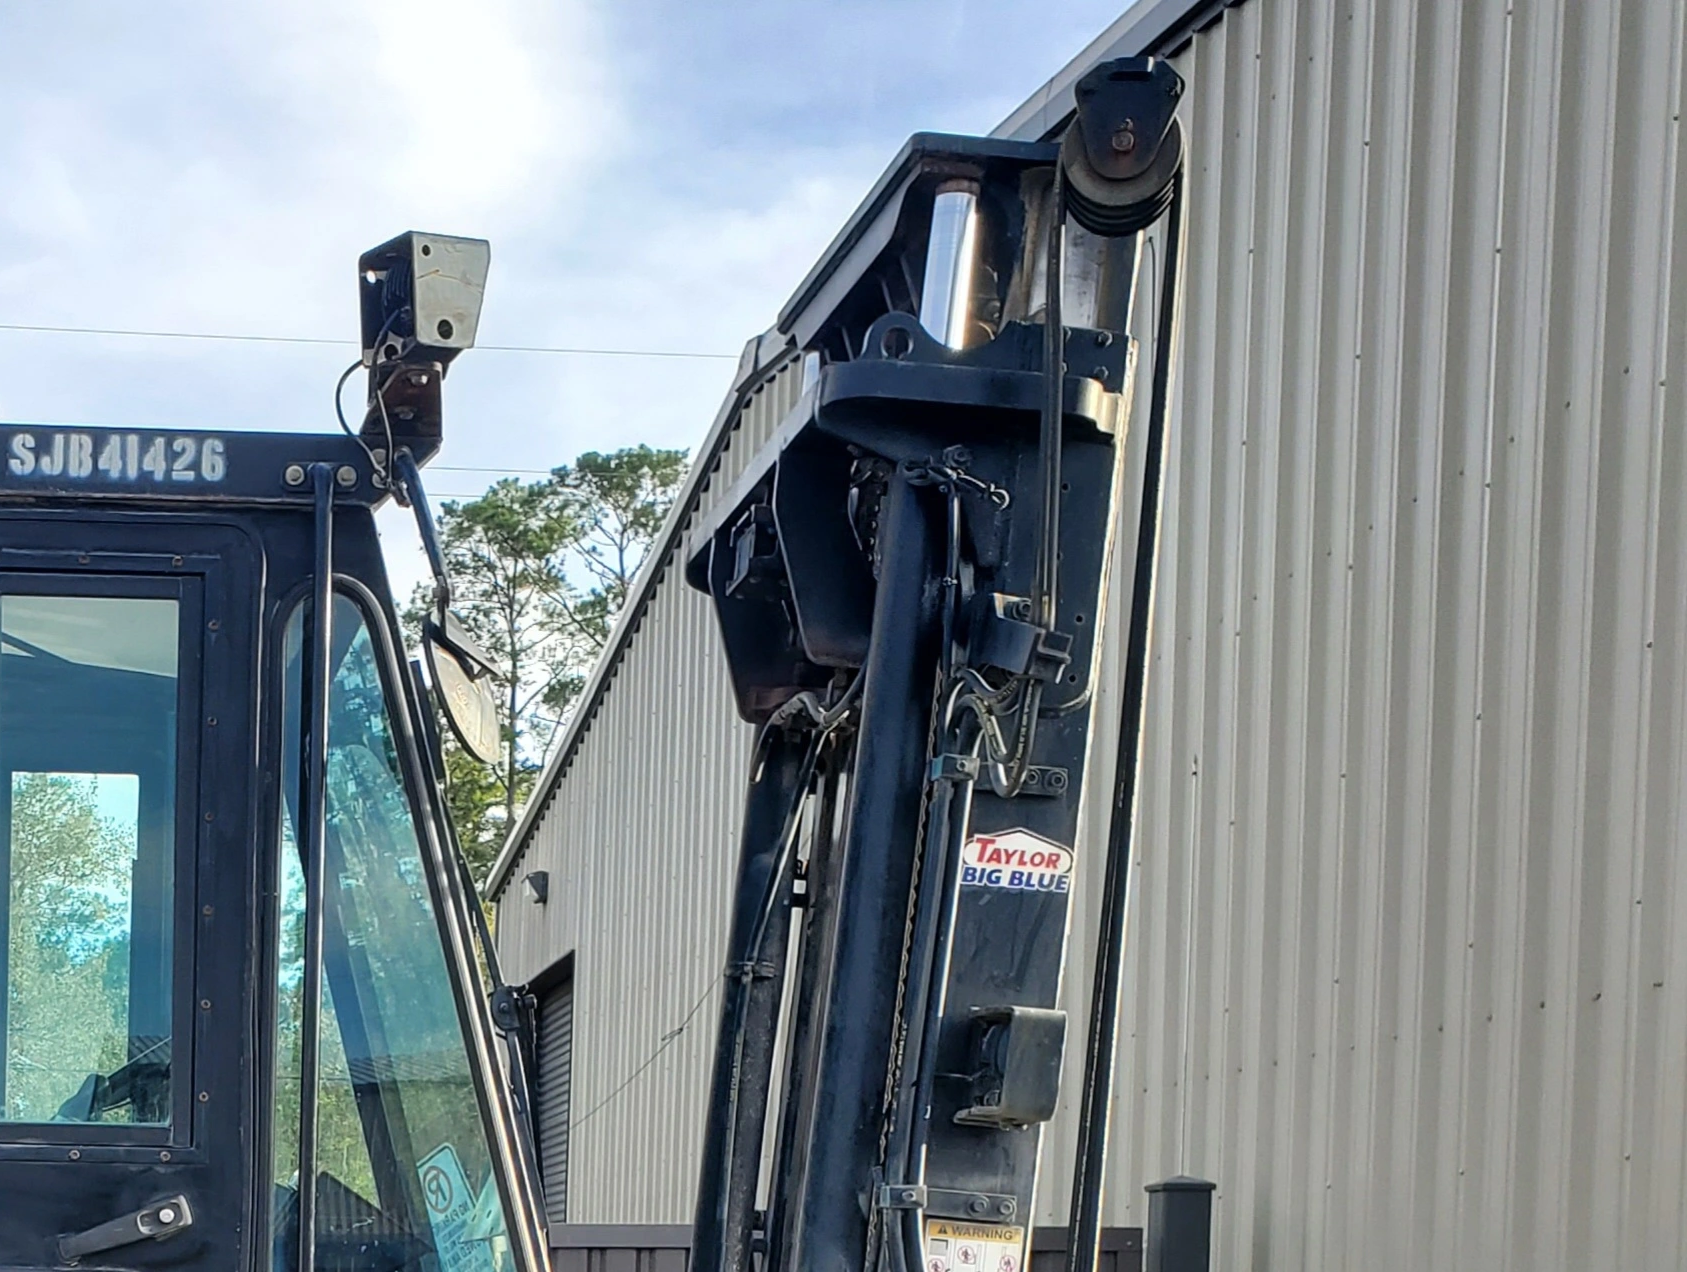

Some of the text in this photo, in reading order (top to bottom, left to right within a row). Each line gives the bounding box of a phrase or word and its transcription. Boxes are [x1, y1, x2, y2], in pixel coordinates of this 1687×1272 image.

[9, 432, 226, 482] SJB41426
[974, 838, 1061, 869] TAYLOR
[961, 867, 1069, 892] BIG BLUE
[951, 1226, 1014, 1241] WARNING
